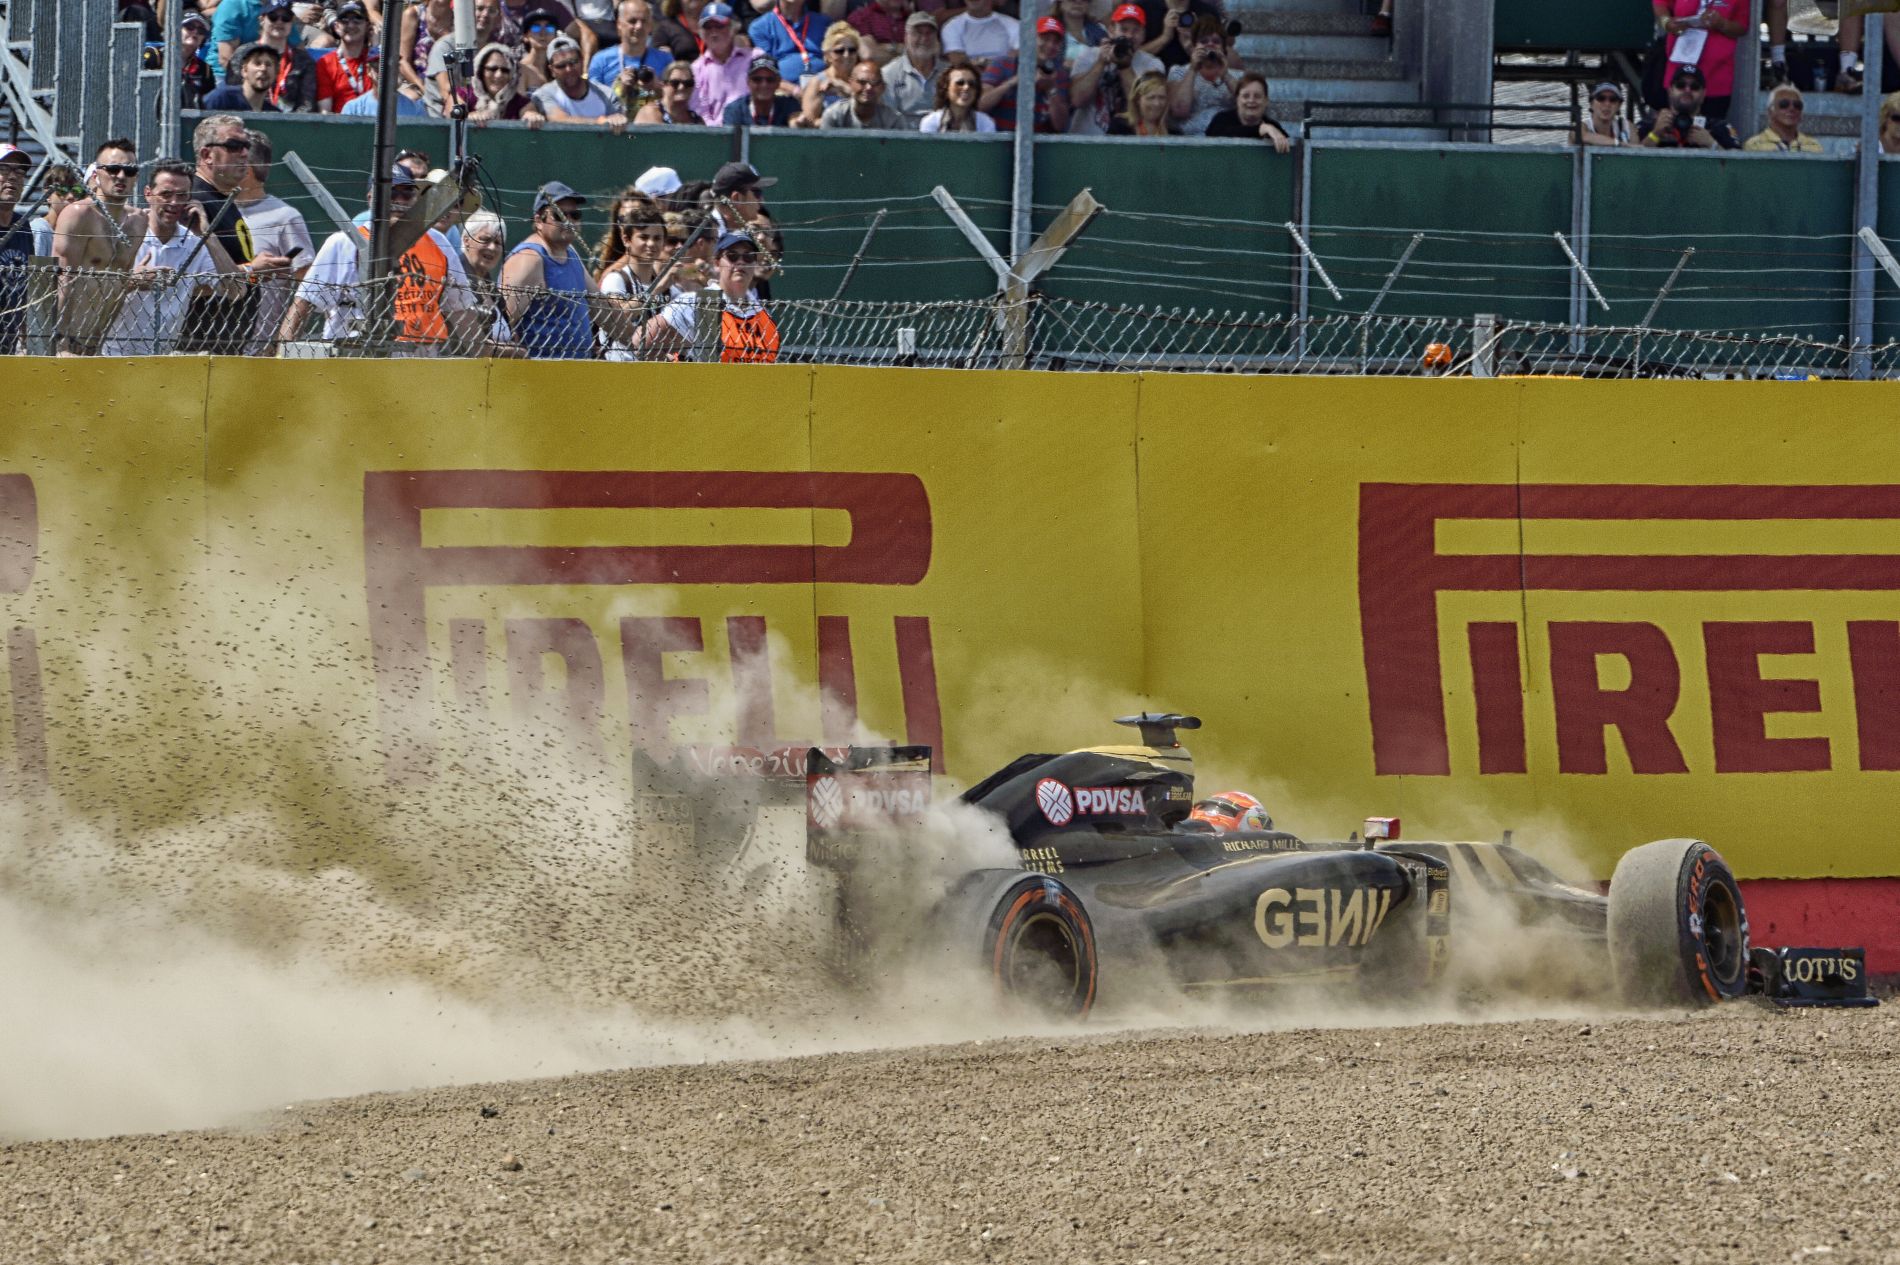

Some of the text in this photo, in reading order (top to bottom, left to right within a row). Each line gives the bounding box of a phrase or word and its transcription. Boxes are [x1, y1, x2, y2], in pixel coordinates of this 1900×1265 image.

[848, 788, 926, 815] PDVSA
[1074, 787, 1147, 814] PDVSA
[1223, 839, 1300, 852] RICHARD MILLE
[1784, 957, 1858, 983] LOTUS
